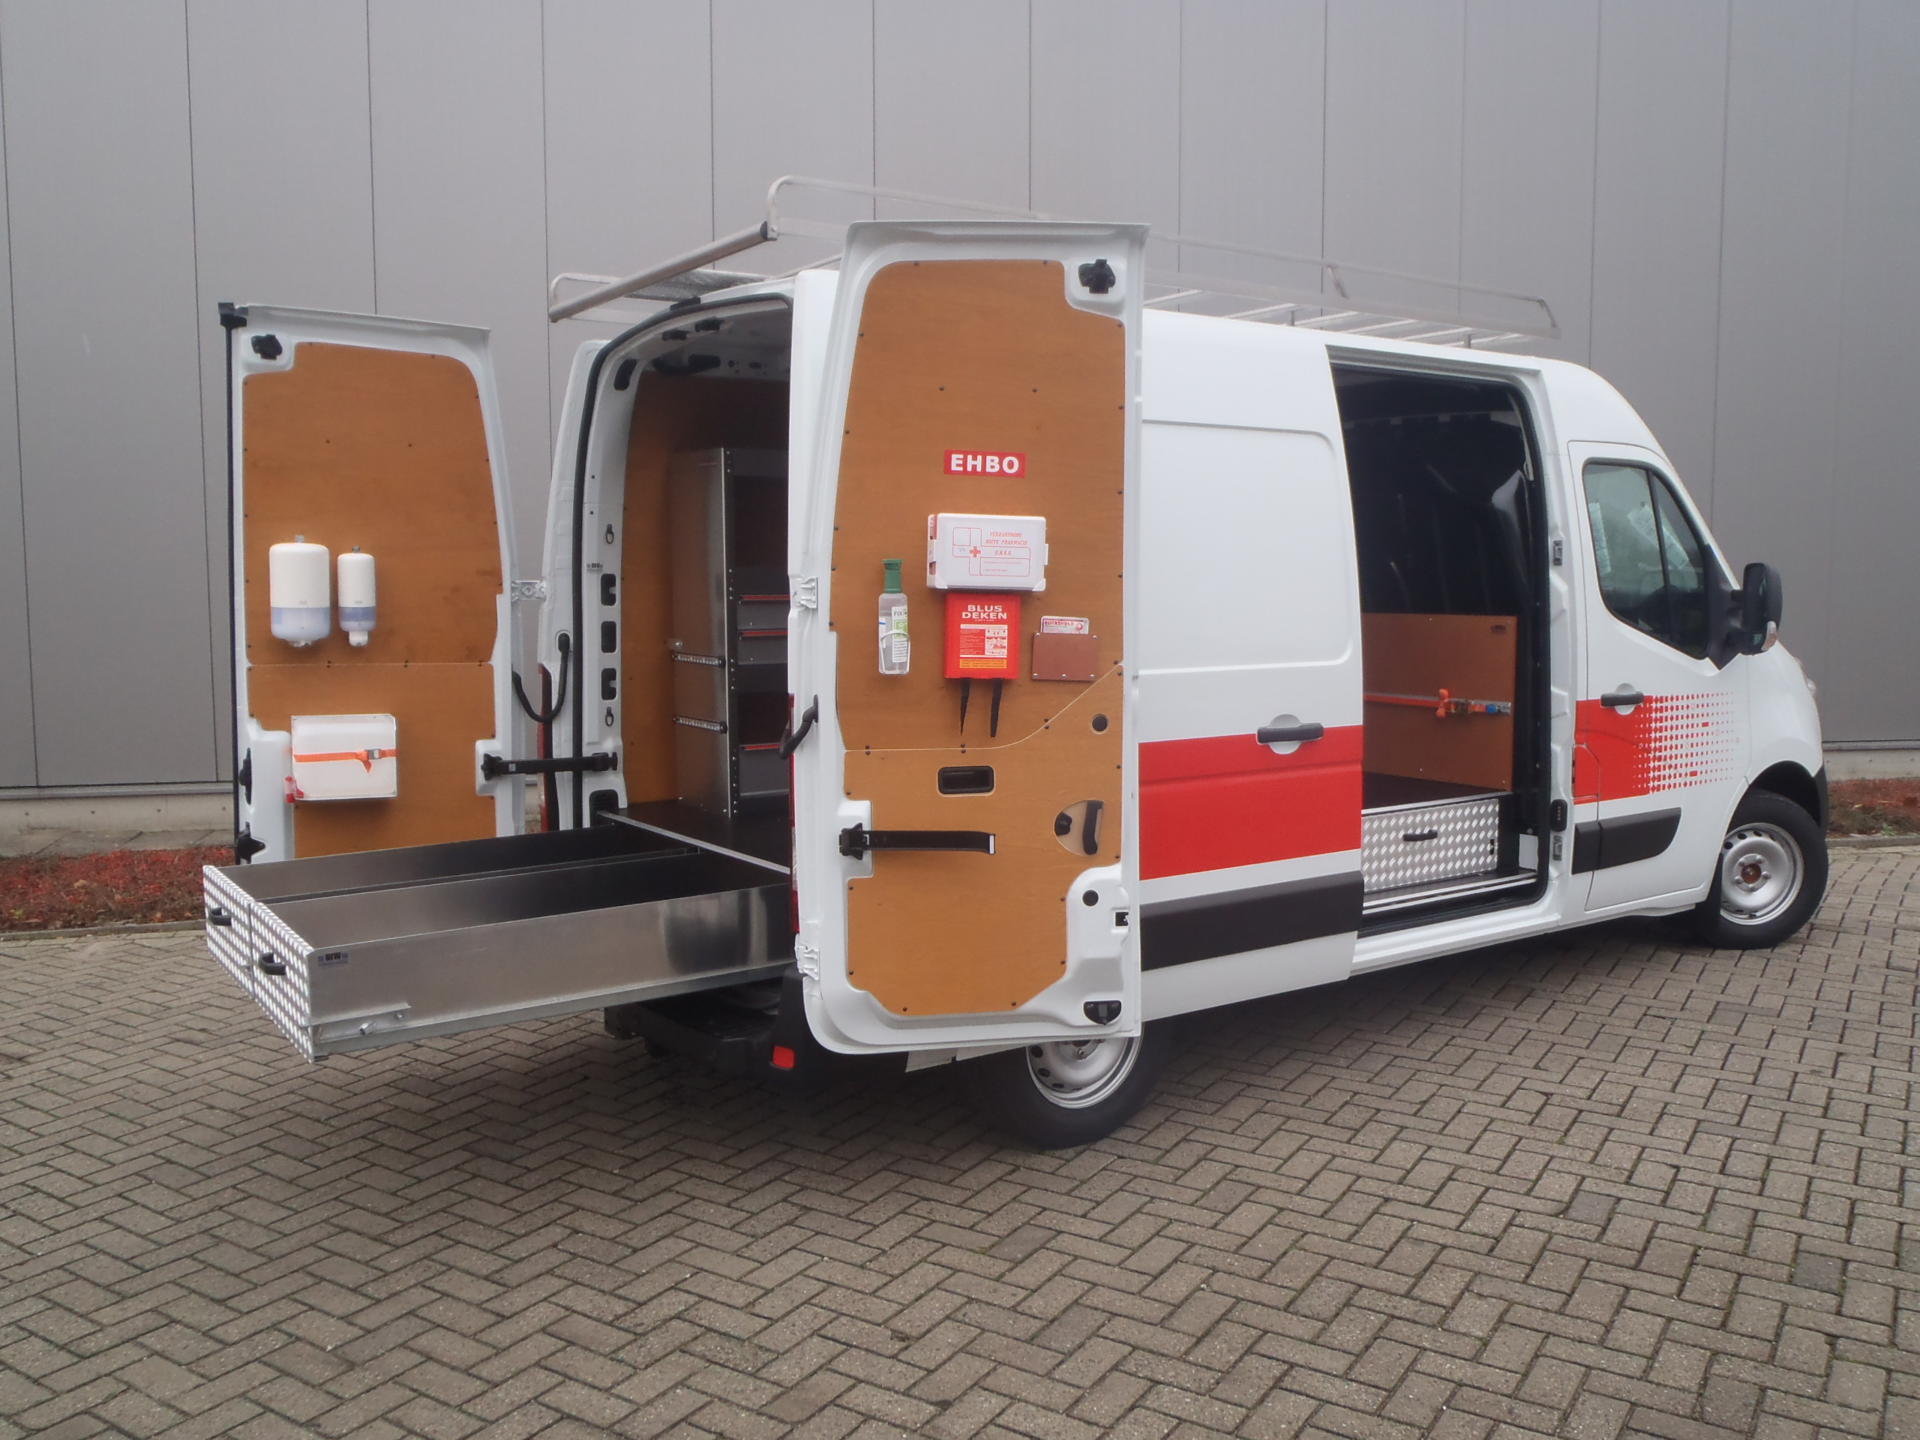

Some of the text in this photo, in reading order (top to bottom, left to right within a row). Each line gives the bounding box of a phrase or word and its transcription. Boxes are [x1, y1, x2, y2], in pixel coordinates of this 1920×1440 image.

[951, 453, 1019, 474] EHBO
[967, 604, 1003, 612] BLUS
[962, 611, 1008, 620] DEKEN
